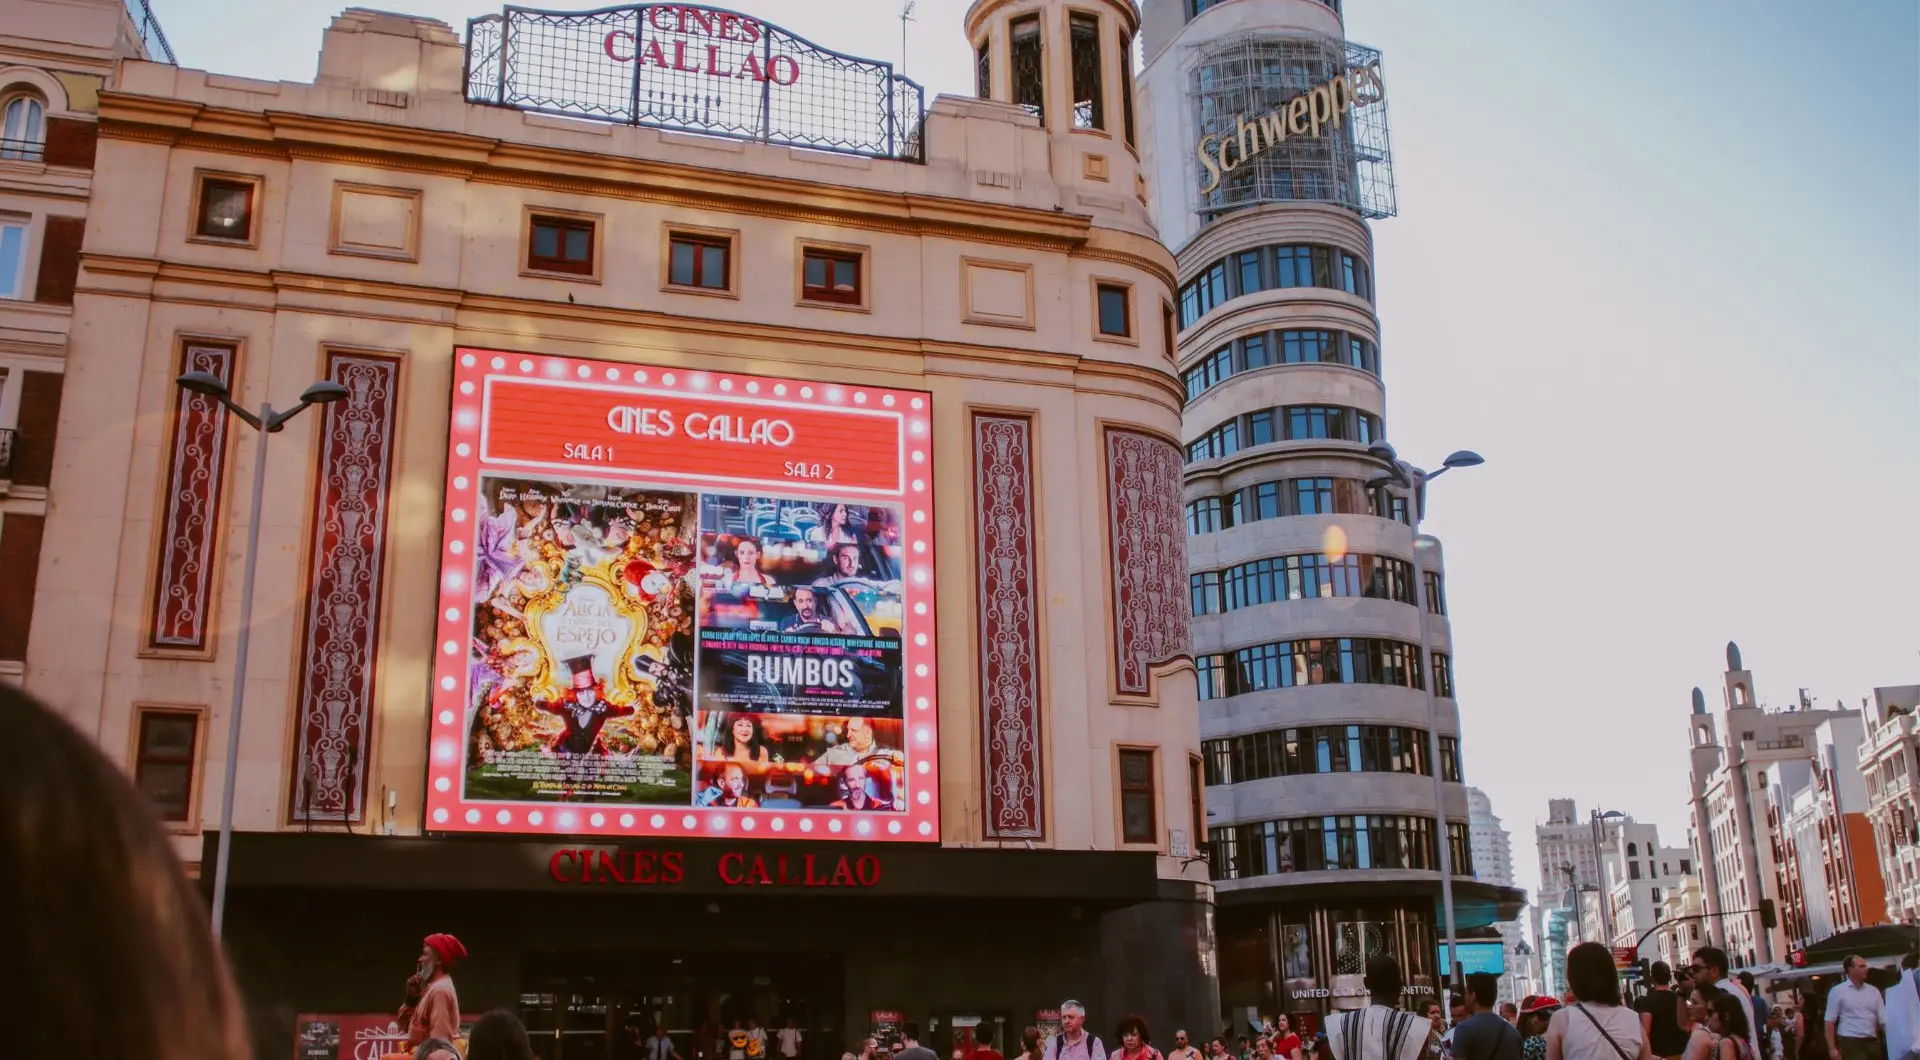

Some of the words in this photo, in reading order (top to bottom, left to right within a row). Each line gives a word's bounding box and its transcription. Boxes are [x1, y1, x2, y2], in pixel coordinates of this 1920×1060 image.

[650, 5, 761, 43] CINES
[604, 30, 800, 86] CALLAO
[1197, 59, 1384, 194] Schweppes
[607, 405, 675, 437] CINES
[684, 412, 795, 447] CALLAO
[563, 443, 602, 461] SALA
[606, 447, 614, 462] 1
[784, 461, 820, 479] SALA
[825, 464, 834, 480] 2
[562, 600, 611, 617] ALICIA
[556, 626, 616, 650] ESPEJO
[747, 655, 854, 688] RUMBOS
[550, 849, 684, 884] CINES
[718, 852, 881, 887] CALLAO
[1292, 988, 1330, 999] UNITED
[1401, 985, 1435, 996] NETTON
